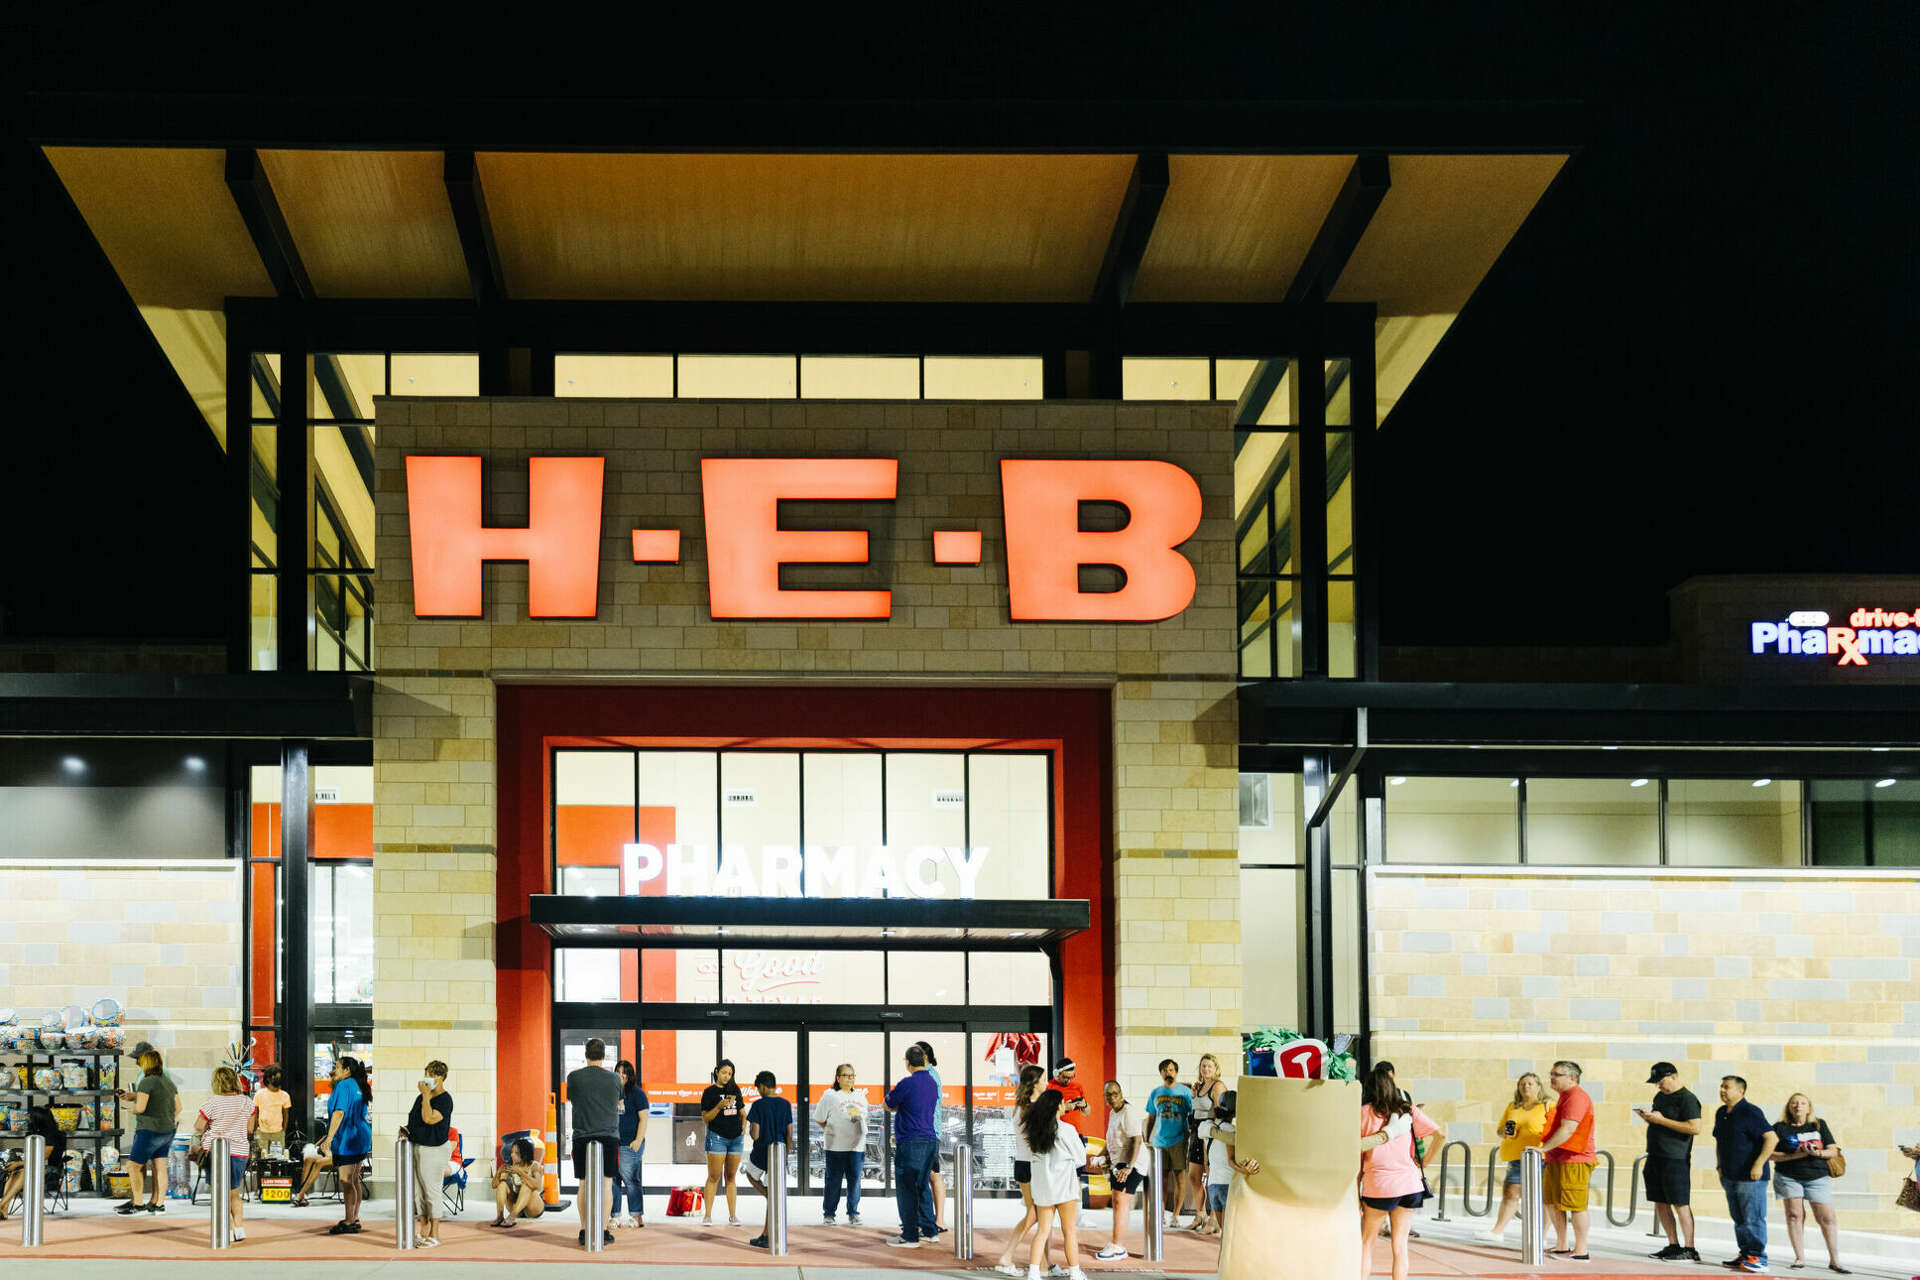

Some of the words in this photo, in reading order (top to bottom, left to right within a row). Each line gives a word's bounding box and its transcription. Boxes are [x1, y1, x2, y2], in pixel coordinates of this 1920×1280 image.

[405, 455, 1203, 623] H-E-B
[1751, 621, 1920, 666] PhaRxma
[622, 842, 991, 899] PHARMACY
